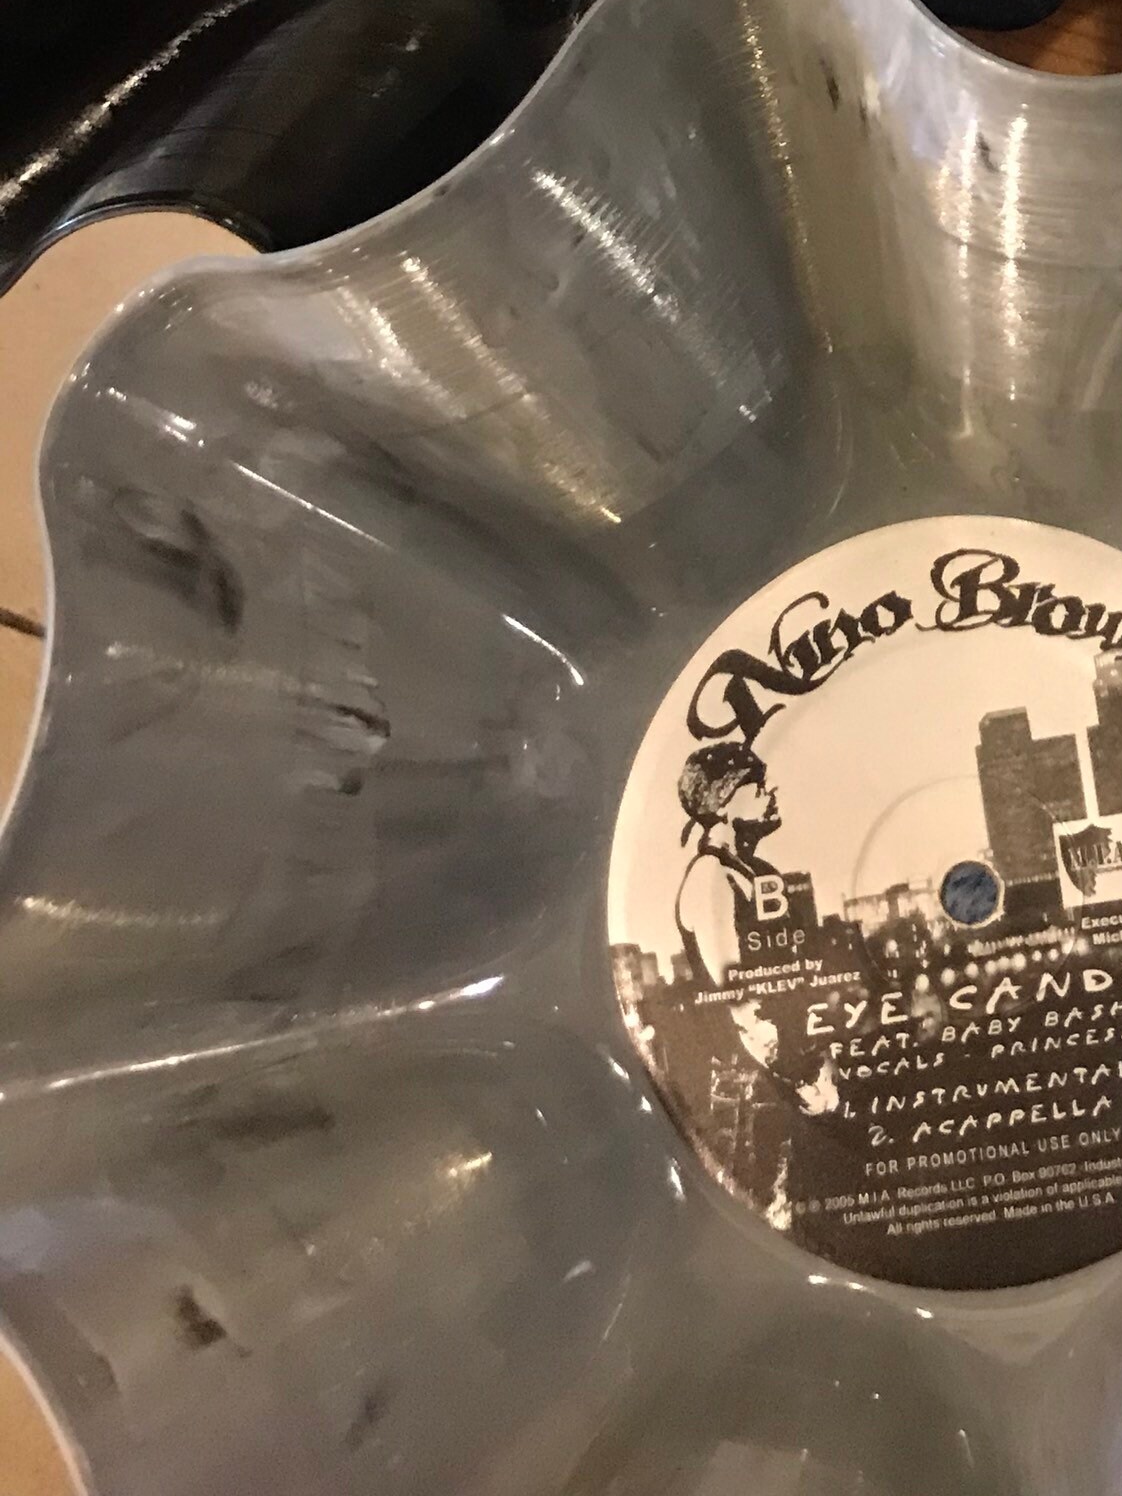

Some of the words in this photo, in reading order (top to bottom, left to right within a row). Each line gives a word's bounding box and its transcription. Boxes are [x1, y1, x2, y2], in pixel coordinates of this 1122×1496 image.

[686, 590, 914, 750] Nino
[753, 874, 789, 921] B
[747, 927, 806, 951] Side
[694, 987, 745, 1005] Jimmy
[810, 971, 861, 988] Juarez
[728, 960, 801, 981] Produced
[804, 958, 823, 972] by
[806, 991, 908, 1036] EYE
[829, 1032, 919, 1060] FEAT.
[941, 1016, 1022, 1043] BABY
[839, 1052, 944, 1080] VOCALS
[867, 1124, 895, 1147] 2.
[912, 1095, 1112, 1143] ACAPPELLA
[865, 1159, 899, 1177] FOR
[907, 1140, 1030, 1171] PROMOTIONAL
[1038, 1134, 1071, 1153] USE
[1078, 1127, 1122, 1147] ONLY
[843, 1205, 895, 1225] Unlawful
[898, 1197, 964, 1219] duplication
[967, 1196, 978, 1207] is
[993, 1186, 1043, 1204] violation
[1046, 1183, 1060, 1196] of
[1061, 1174, 1122, 1195] applicable
[897, 1182, 948, 1200] Records
[950, 1177, 976, 1191] LLC
[1012, 1169, 1035, 1184] Box
[887, 1223, 903, 1236] All
[906, 1216, 940, 1235] rights
[1003, 1202, 1038, 1220] Made
[1041, 1201, 1053, 1213] in
[1055, 1198, 1075, 1212] the
